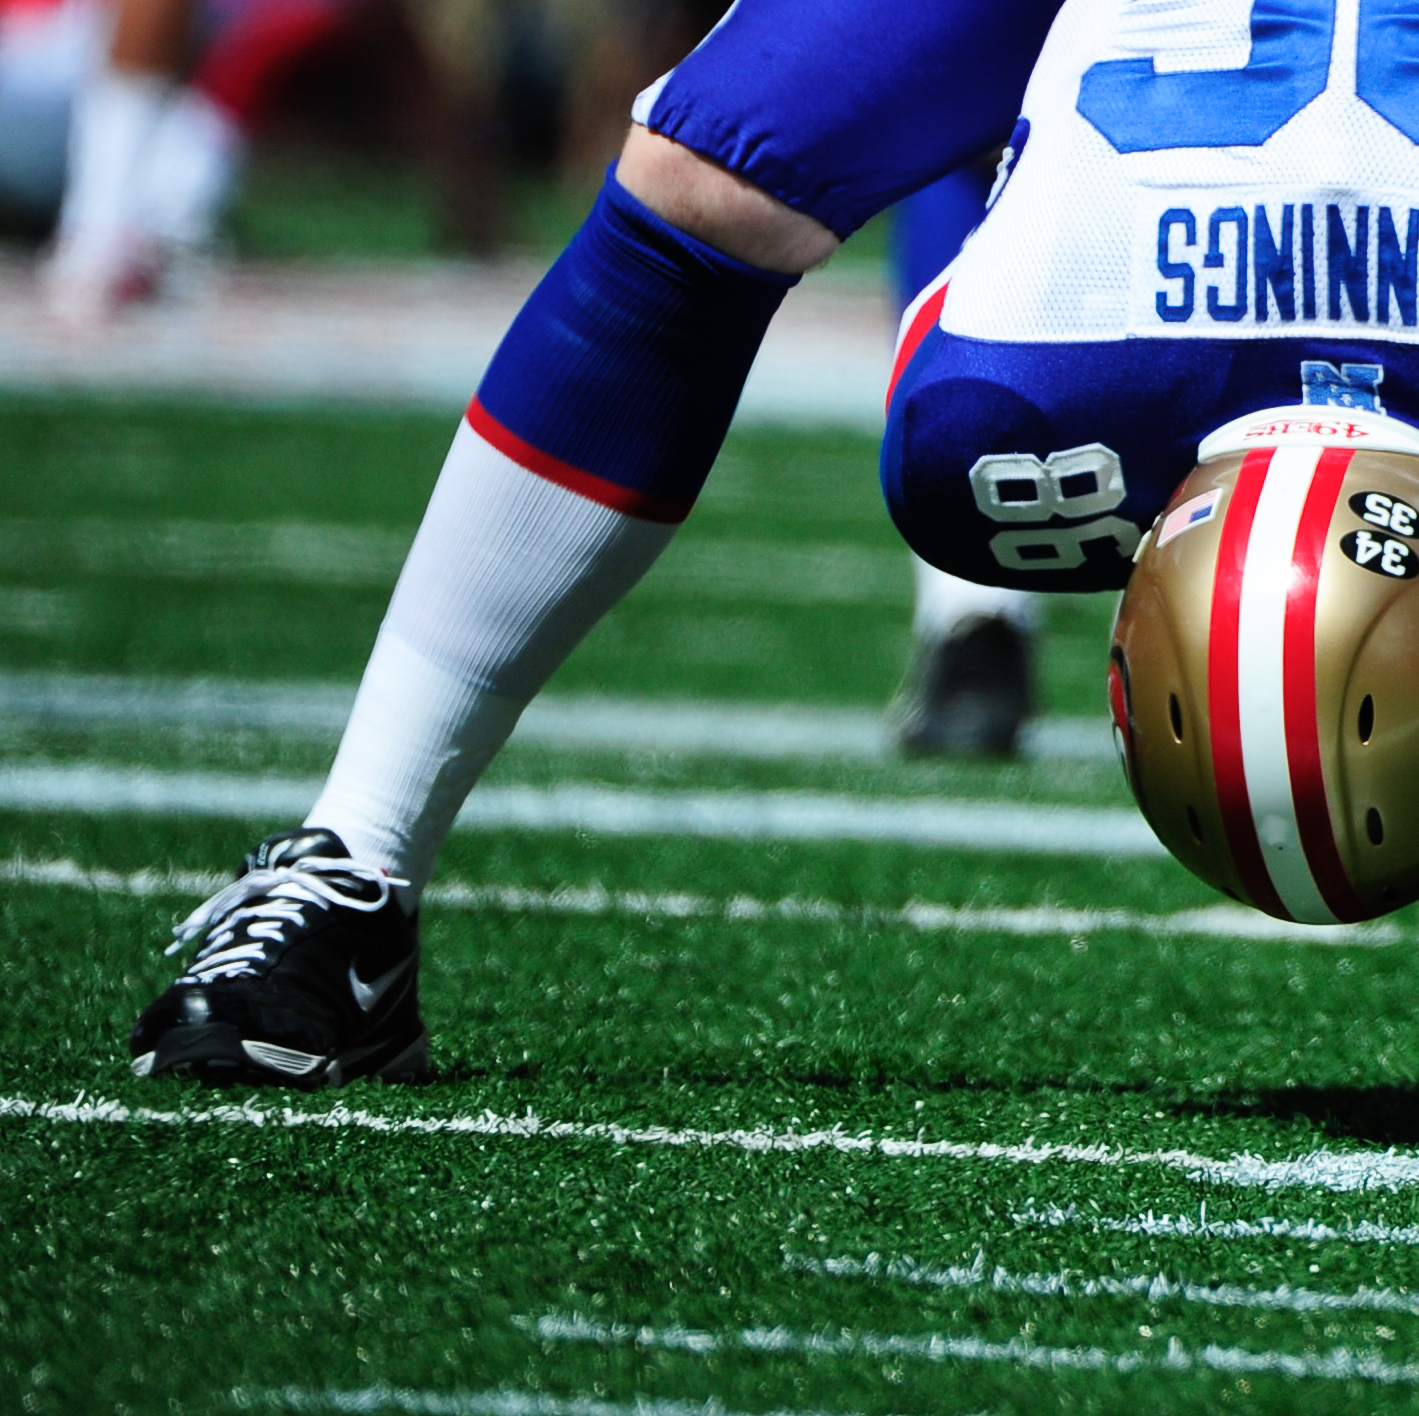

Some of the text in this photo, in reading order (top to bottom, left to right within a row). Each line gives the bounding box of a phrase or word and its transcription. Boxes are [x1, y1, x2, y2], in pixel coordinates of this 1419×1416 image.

[968, 441, 1143, 572] 86
[1363, 493, 1418, 537] 35
[1355, 530, 1410, 577] 34
